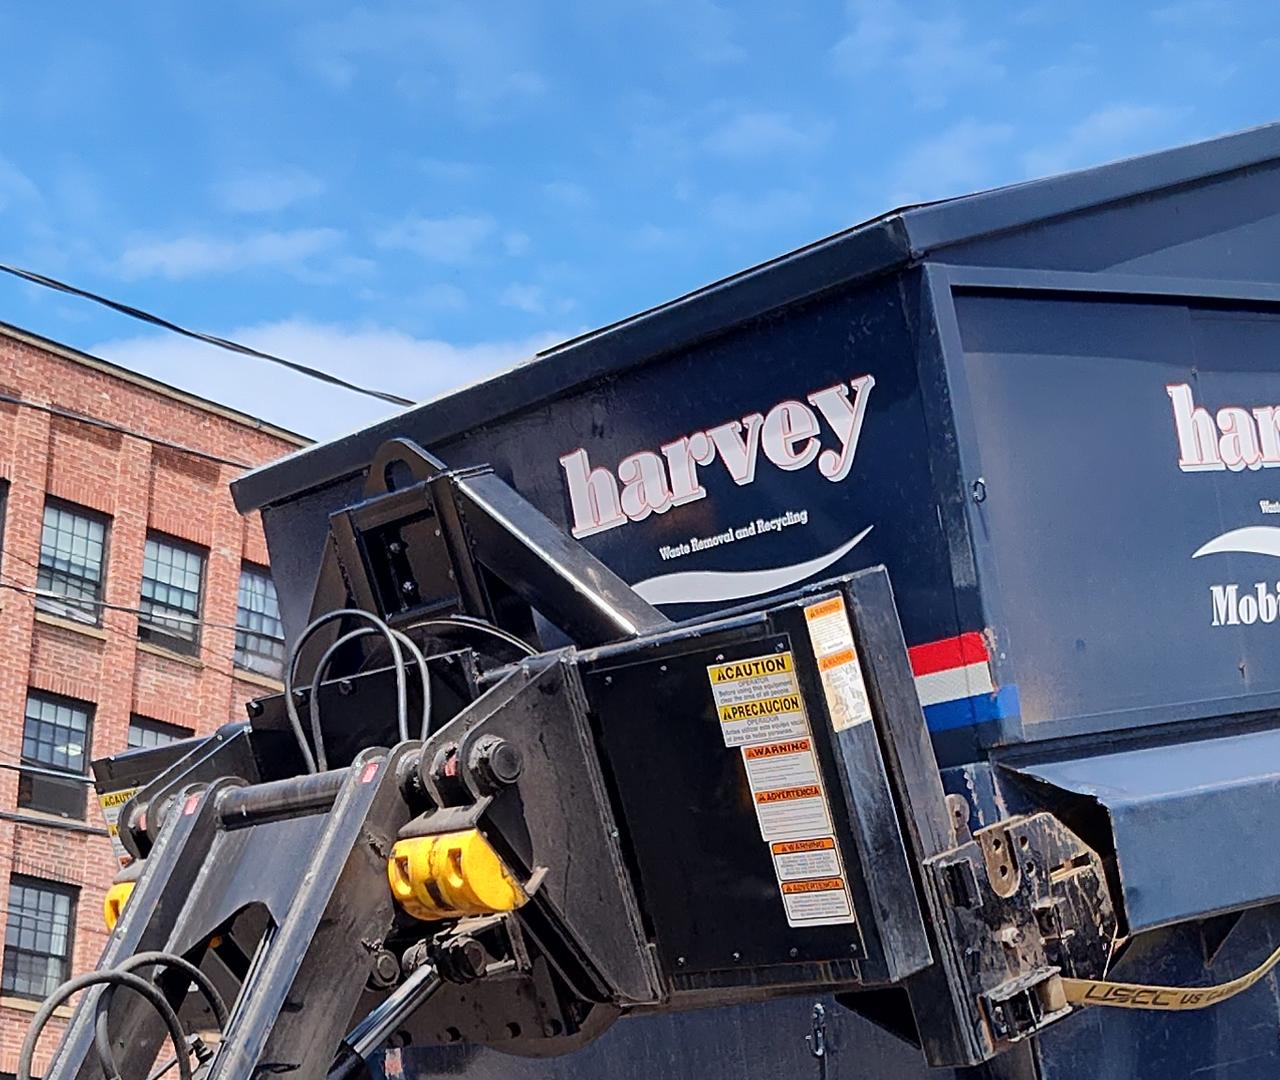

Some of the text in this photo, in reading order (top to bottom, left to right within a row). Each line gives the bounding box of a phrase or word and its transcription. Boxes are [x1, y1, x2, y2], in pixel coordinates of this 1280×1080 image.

[560, 374, 875, 539] harvey
[659, 510, 808, 560] Waste Removal and Recycling
[725, 657, 786, 679] CAUTION
[755, 742, 808, 756] WARNING
[767, 787, 819, 801] ADVERTENCIA
[1180, 993, 1203, 1005] US
